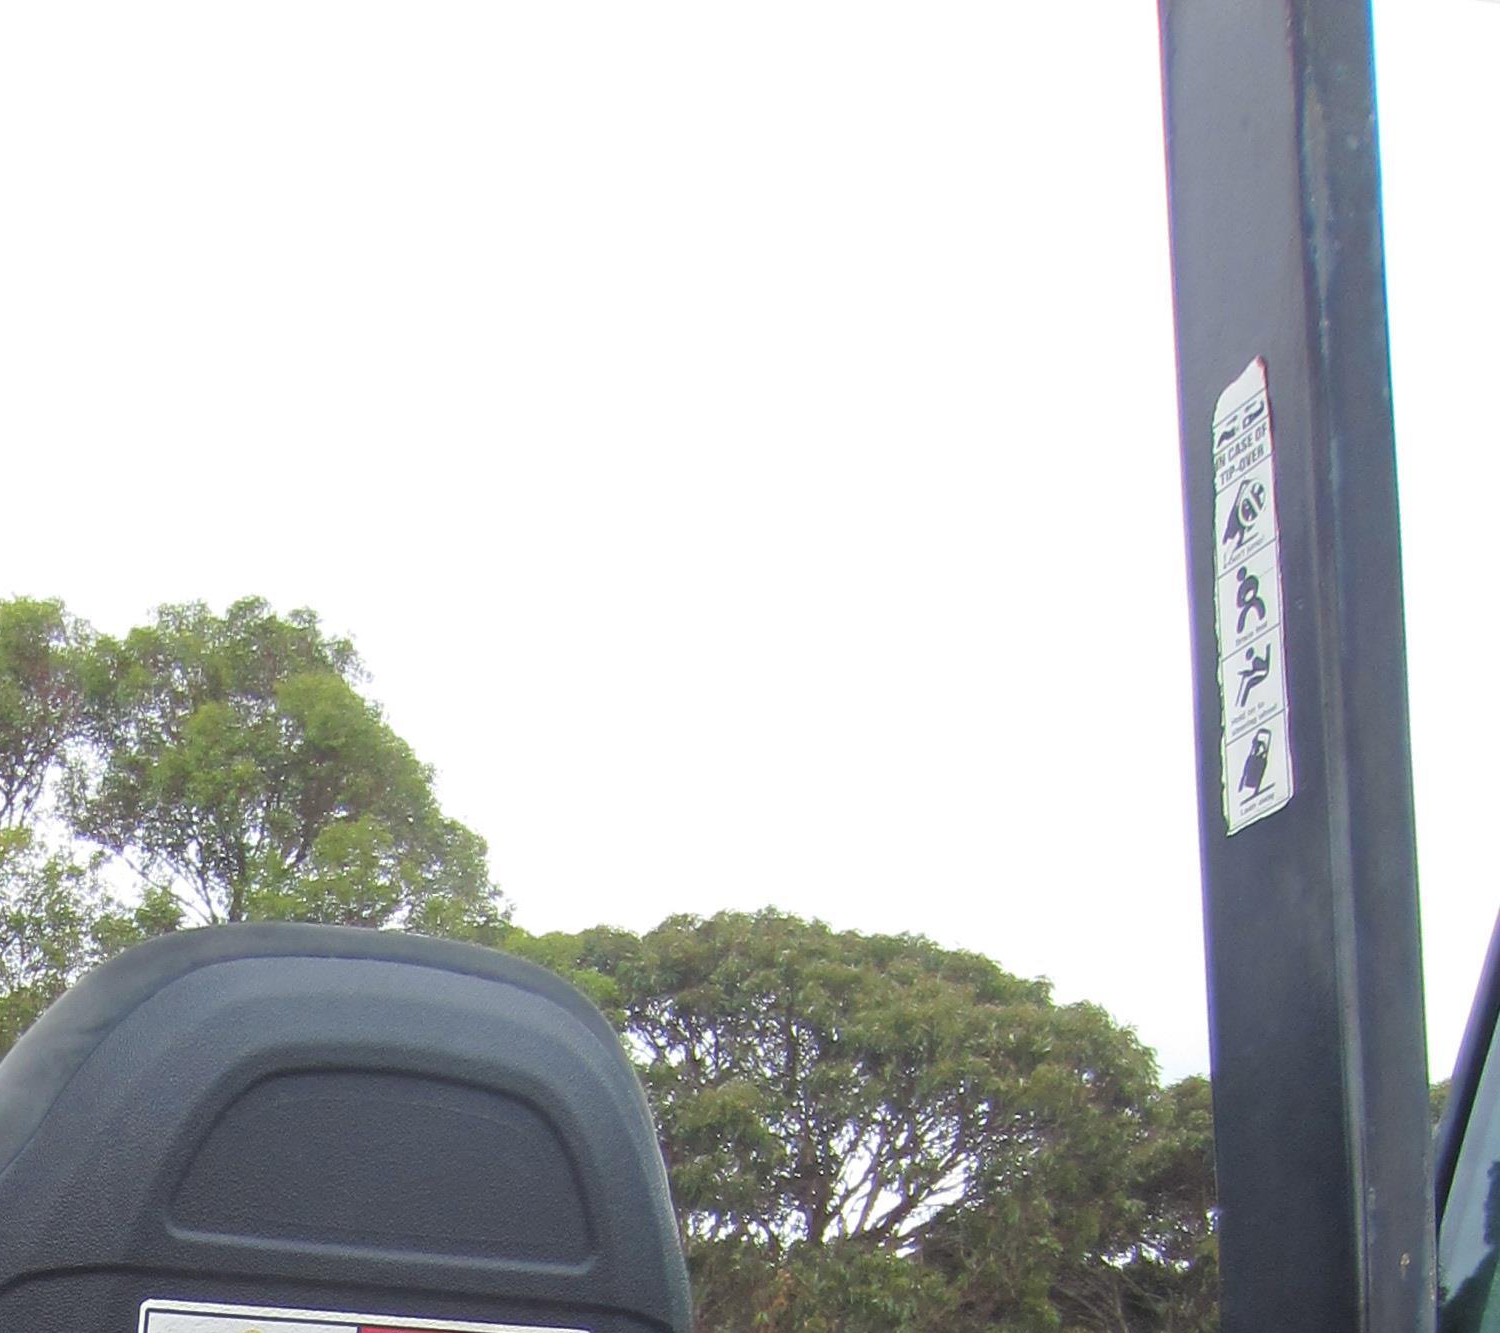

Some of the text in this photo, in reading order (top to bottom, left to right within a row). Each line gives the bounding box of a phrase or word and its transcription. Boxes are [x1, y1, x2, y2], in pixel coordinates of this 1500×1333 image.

[1227, 433, 1254, 462] CASE
[1255, 422, 1268, 442] OF
[1219, 443, 1265, 486] TIP-OVER
